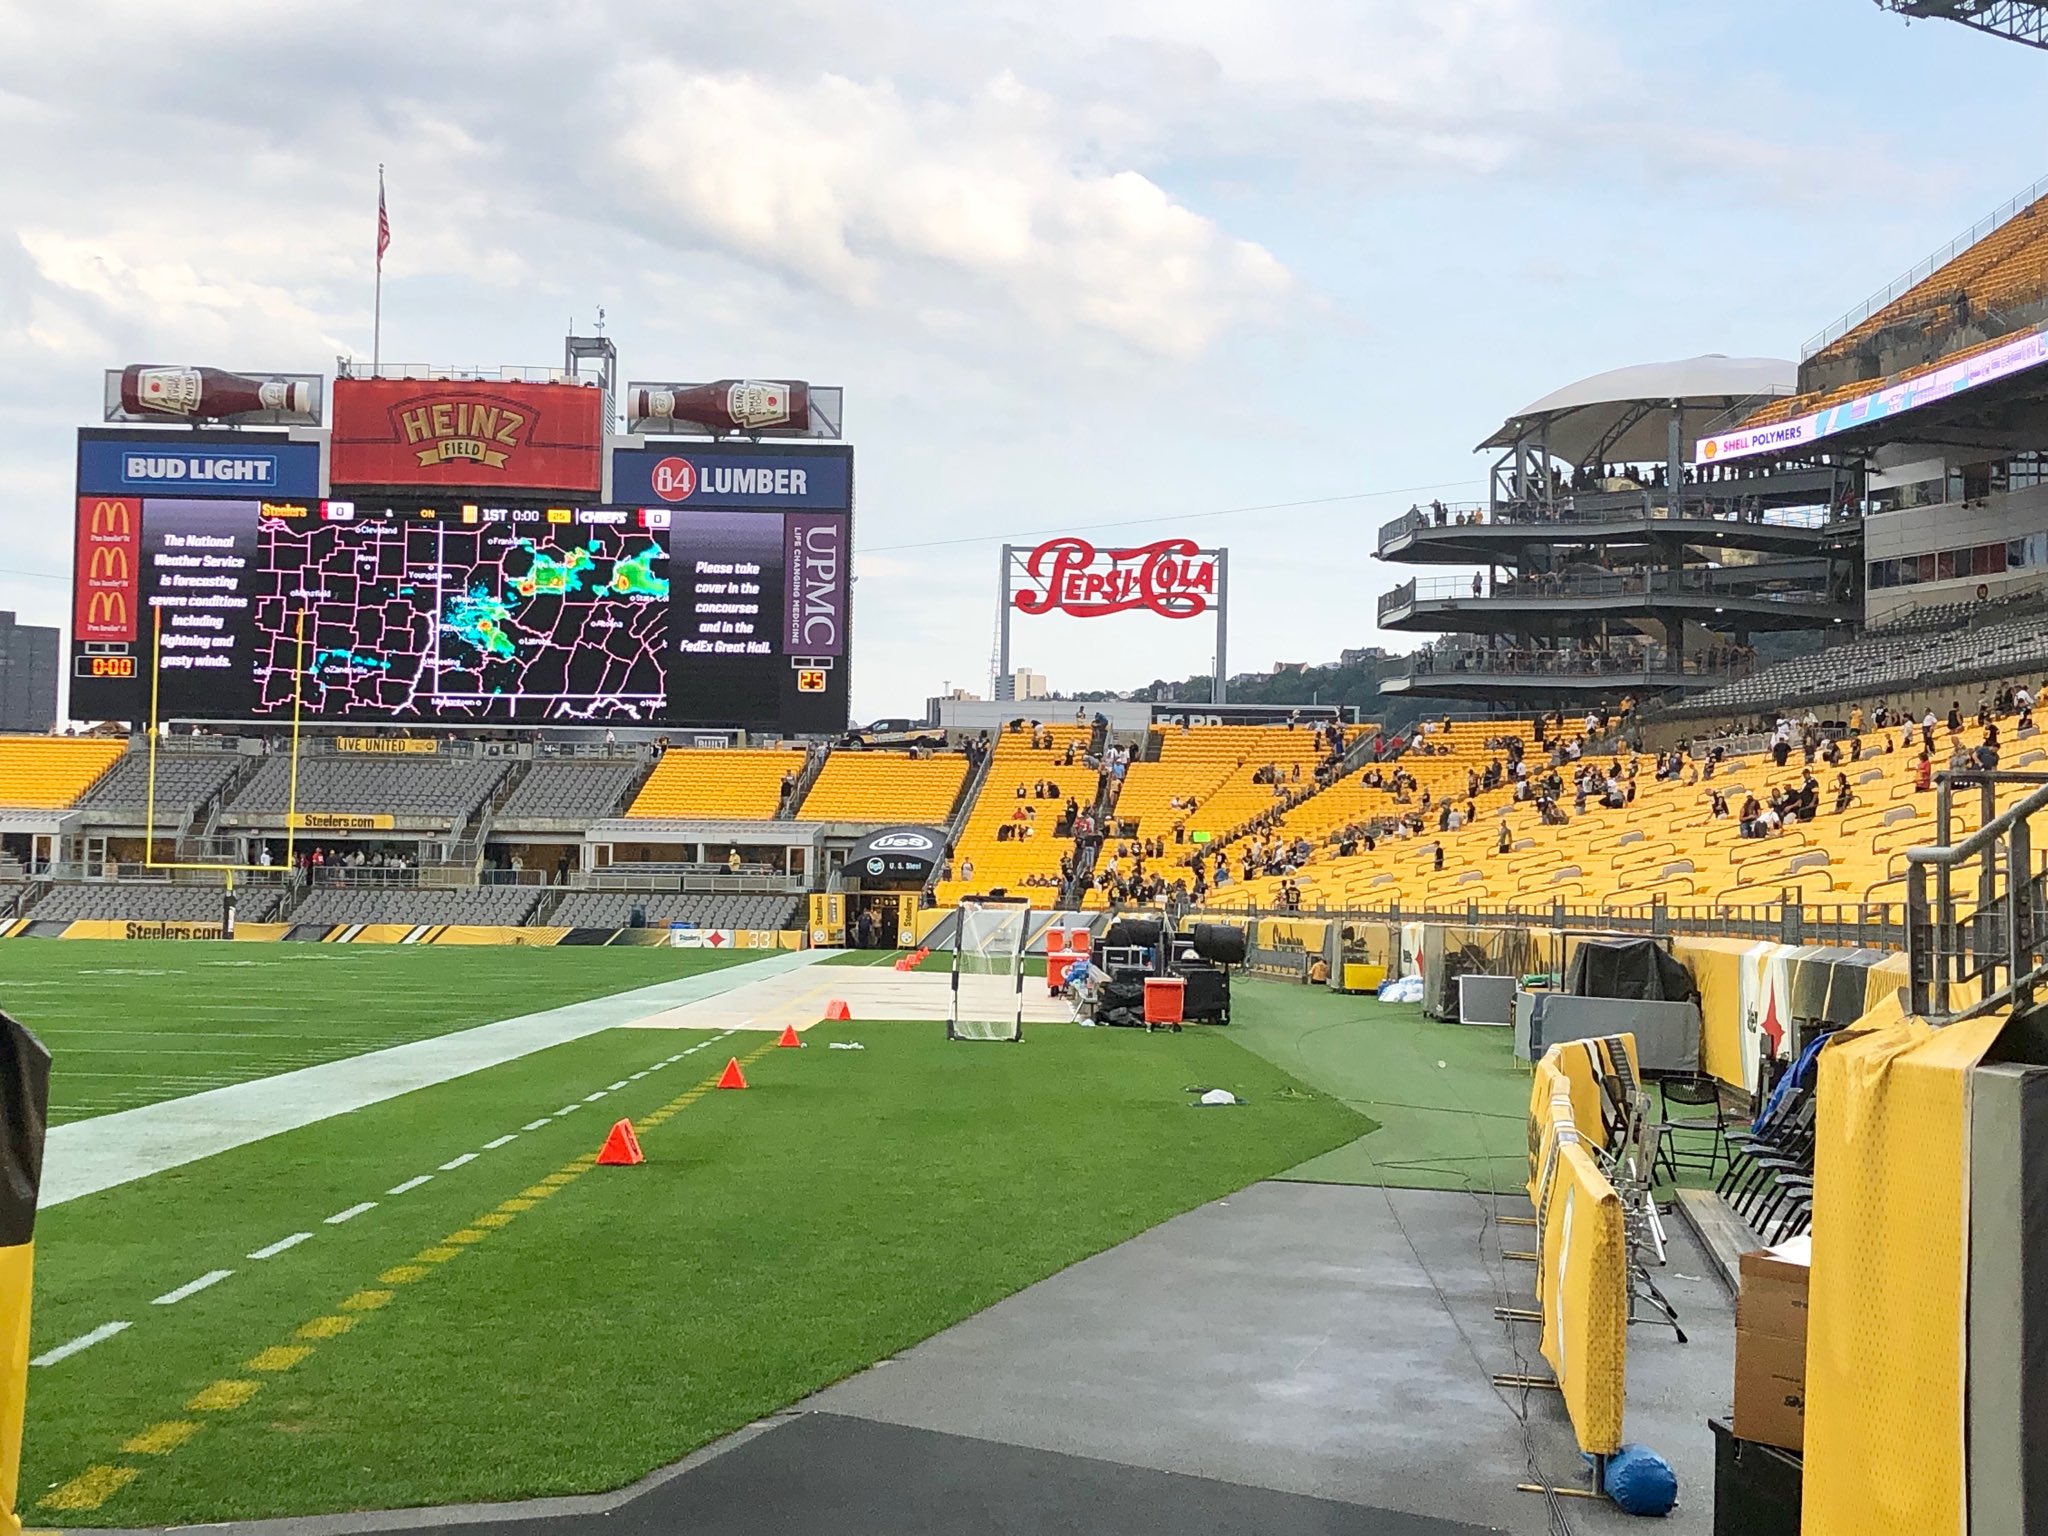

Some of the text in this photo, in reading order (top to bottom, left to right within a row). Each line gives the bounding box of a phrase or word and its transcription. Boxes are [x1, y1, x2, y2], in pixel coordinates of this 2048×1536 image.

[735, 389, 745, 415] HEINZ
[402, 403, 525, 446] HEINZ
[1723, 425, 1801, 453] SHELL POLYMERS
[444, 443, 480, 456] FIELD
[128, 458, 271, 480] BUD LIGHT
[658, 466, 807, 495] 84 LUMBER
[263, 504, 307, 518] Steelers
[336, 508, 344, 516] 0
[420, 510, 436, 518] ON
[483, 510, 539, 522] 1ST 0:00
[580, 512, 628, 524] CHIEFS
[654, 515, 662, 524] 0
[362, 526, 398, 534] Cleveland
[165, 534, 234, 548] The National
[154, 554, 246, 568] Weather Service
[696, 561, 760, 574] Please take
[160, 574, 238, 590] is forecasting
[696, 582, 760, 594] cover in the
[792, 527, 802, 644] LIFE CHANGING MEDICINE
[804, 524, 836, 646] UPMC
[149, 596, 248, 608] severe conditions
[696, 603, 758, 614] concourses
[172, 614, 224, 630] including
[699, 621, 754, 634] and in the
[160, 634, 234, 649] lightning and
[680, 640, 772, 654] FedEx Great Hall.
[93, 659, 131, 675] 0:00
[160, 656, 232, 668] gusty winds.
[801, 672, 823, 690] 25
[337, 740, 361, 751] LIVE
[366, 740, 406, 752] UNITED
[698, 740, 725, 748] BUILT
[304, 814, 374, 828] Steelers.com
[904, 897, 912, 927] Steelers
[126, 922, 222, 940] Steelers.com
[748, 932, 770, 948] 33
